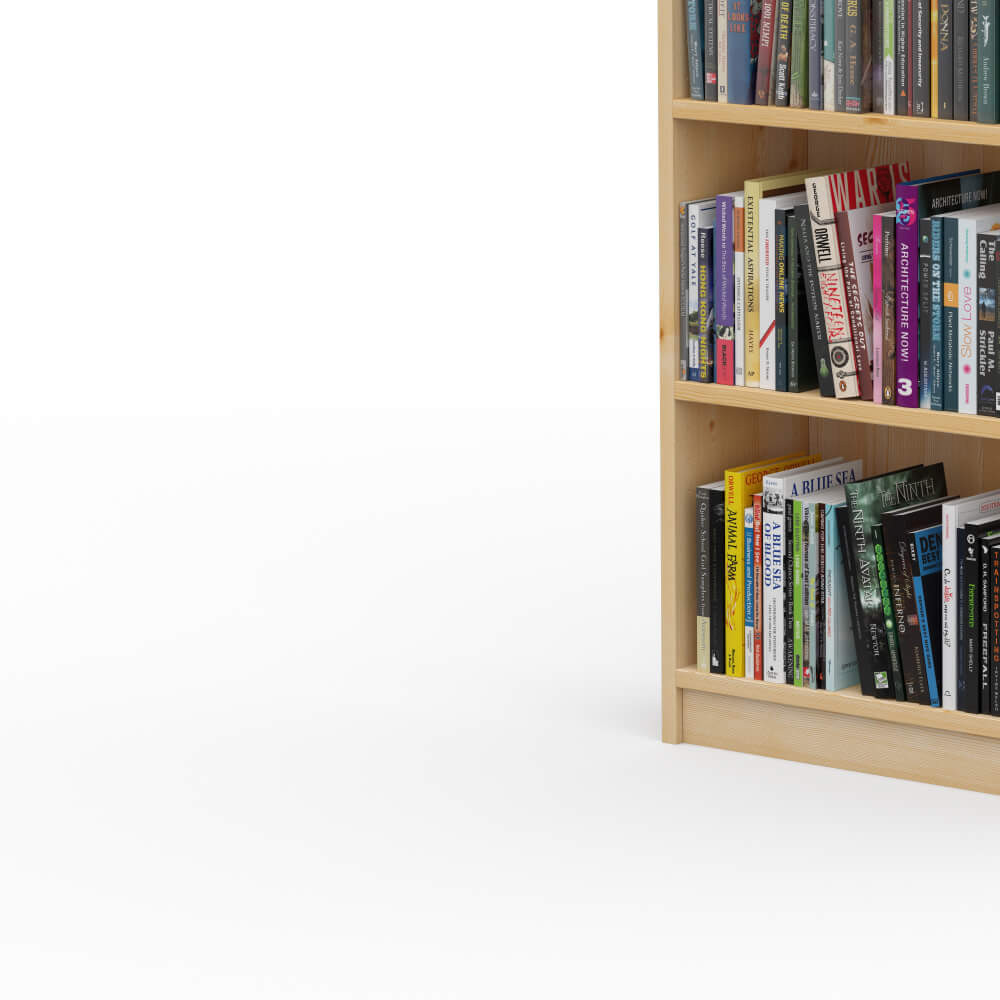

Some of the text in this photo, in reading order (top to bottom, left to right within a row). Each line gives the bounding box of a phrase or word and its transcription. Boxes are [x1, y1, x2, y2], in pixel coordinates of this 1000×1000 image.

[781, 1, 790, 12] OF
[780, 14, 789, 39] DEATH
[778, 64, 786, 81] Scott
[778, 83, 786, 100] Keith
[691, 246, 696, 256] AT
[815, 229, 831, 263] ORWELL
[978, 240, 987, 279] Calling
[932, 220, 940, 340] RIDERS ON THE STORM
[852, 285, 863, 328] SECRETS
[900, 243, 908, 362] ARCHITECTURE NOW!
[961, 287, 972, 358] Slow Love
[979, 329, 987, 376] Strickler
[988, 359, 995, 372] M.
[898, 378, 912, 396] 3
[727, 508, 737, 550] ANIMAL
[764, 523, 771, 538] OF
[772, 534, 781, 562] BLUE
[727, 554, 737, 580] FARM
[772, 568, 781, 590] SEA
[893, 584, 905, 632] INFERNO
